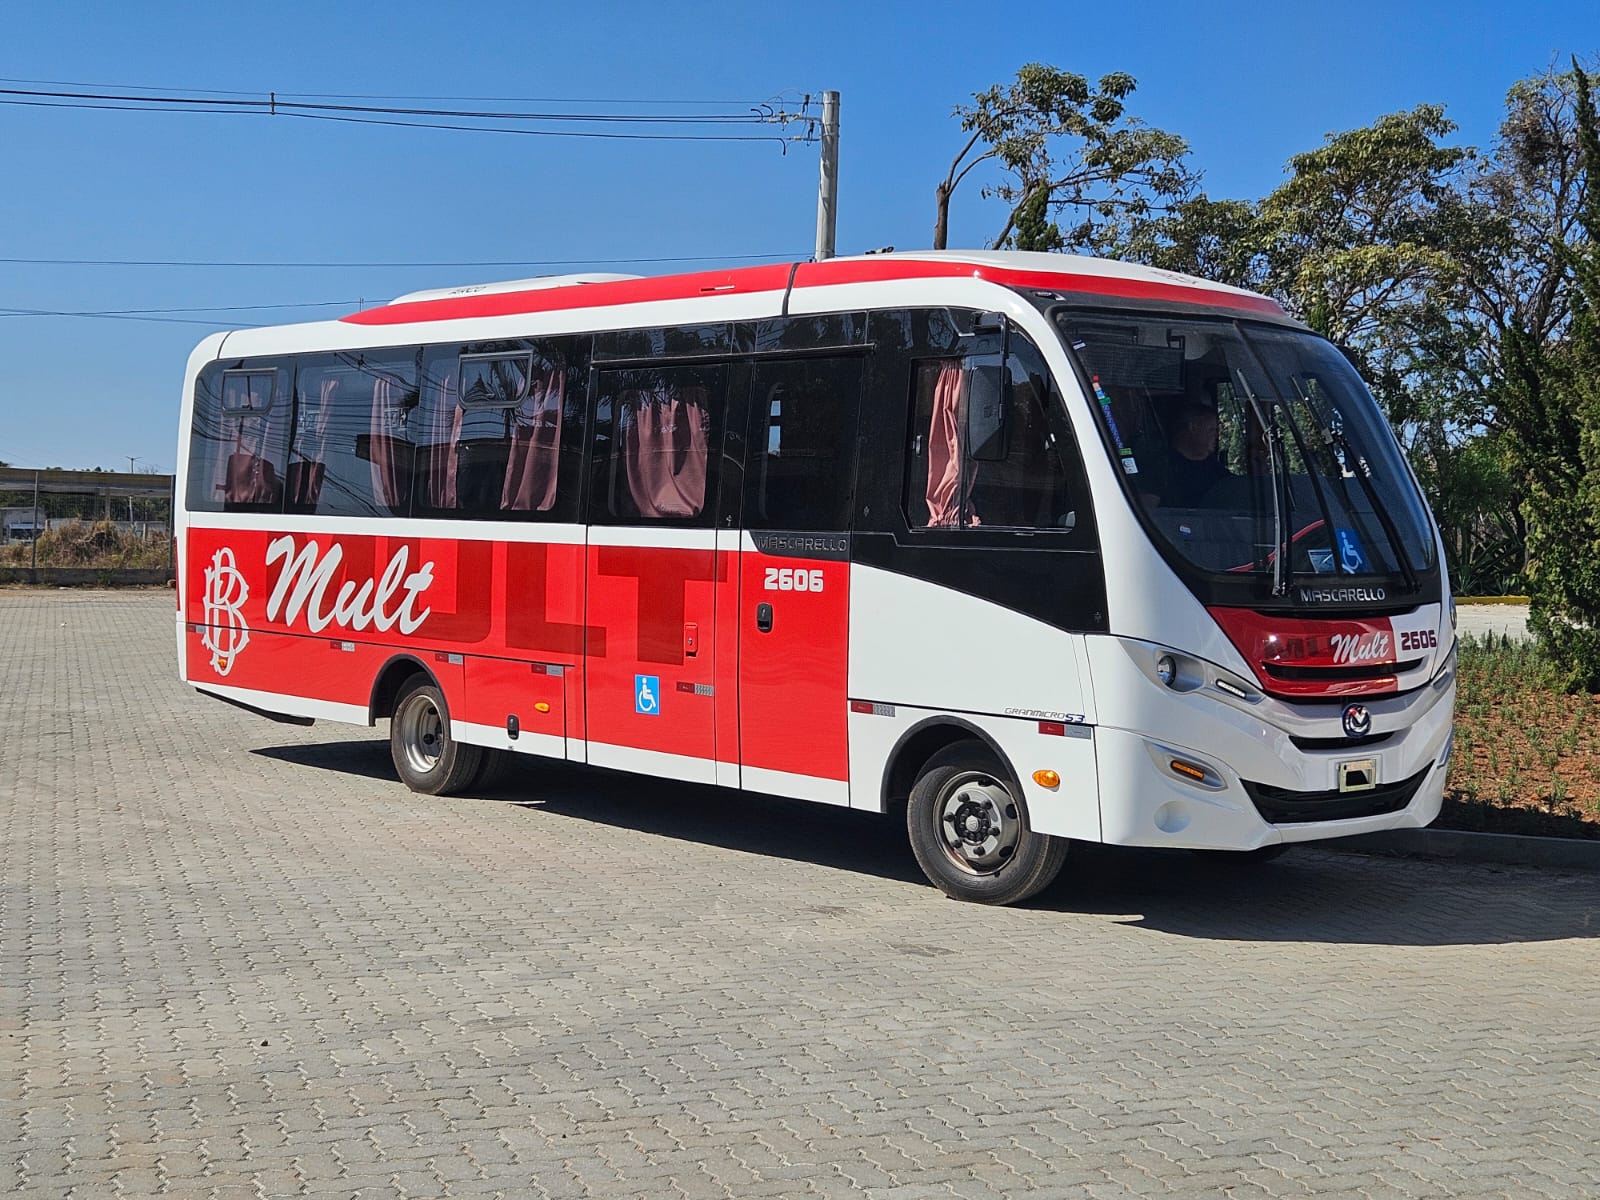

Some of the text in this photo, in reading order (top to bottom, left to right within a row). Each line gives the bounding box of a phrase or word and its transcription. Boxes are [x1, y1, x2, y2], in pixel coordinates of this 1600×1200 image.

[758, 535, 848, 553] MASCARELLO
[265, 534, 434, 634] Mult
[764, 567, 824, 593] 2606
[1300, 588, 1386, 602] MASCARELLO
[1331, 632, 1389, 664] Mult
[1401, 629, 1437, 651] 2606
